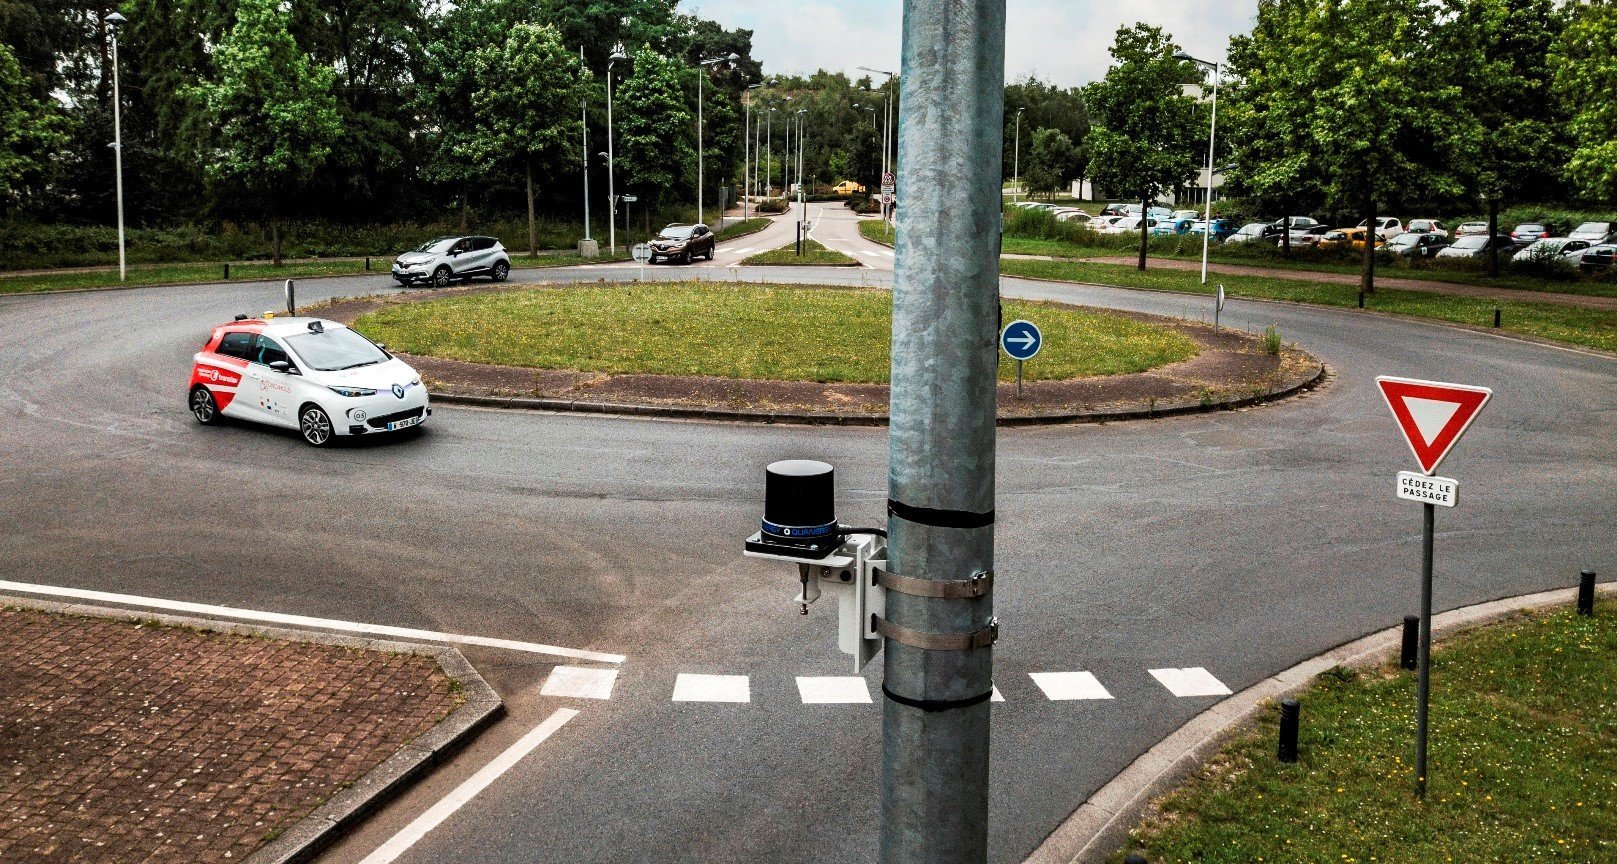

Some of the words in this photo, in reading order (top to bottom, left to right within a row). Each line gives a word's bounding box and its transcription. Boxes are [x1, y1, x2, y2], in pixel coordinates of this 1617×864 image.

[1402, 478, 1434, 490] CÉDEZ
[1439, 484, 1451, 493] LE
[1403, 487, 1448, 502] PASSAGE
